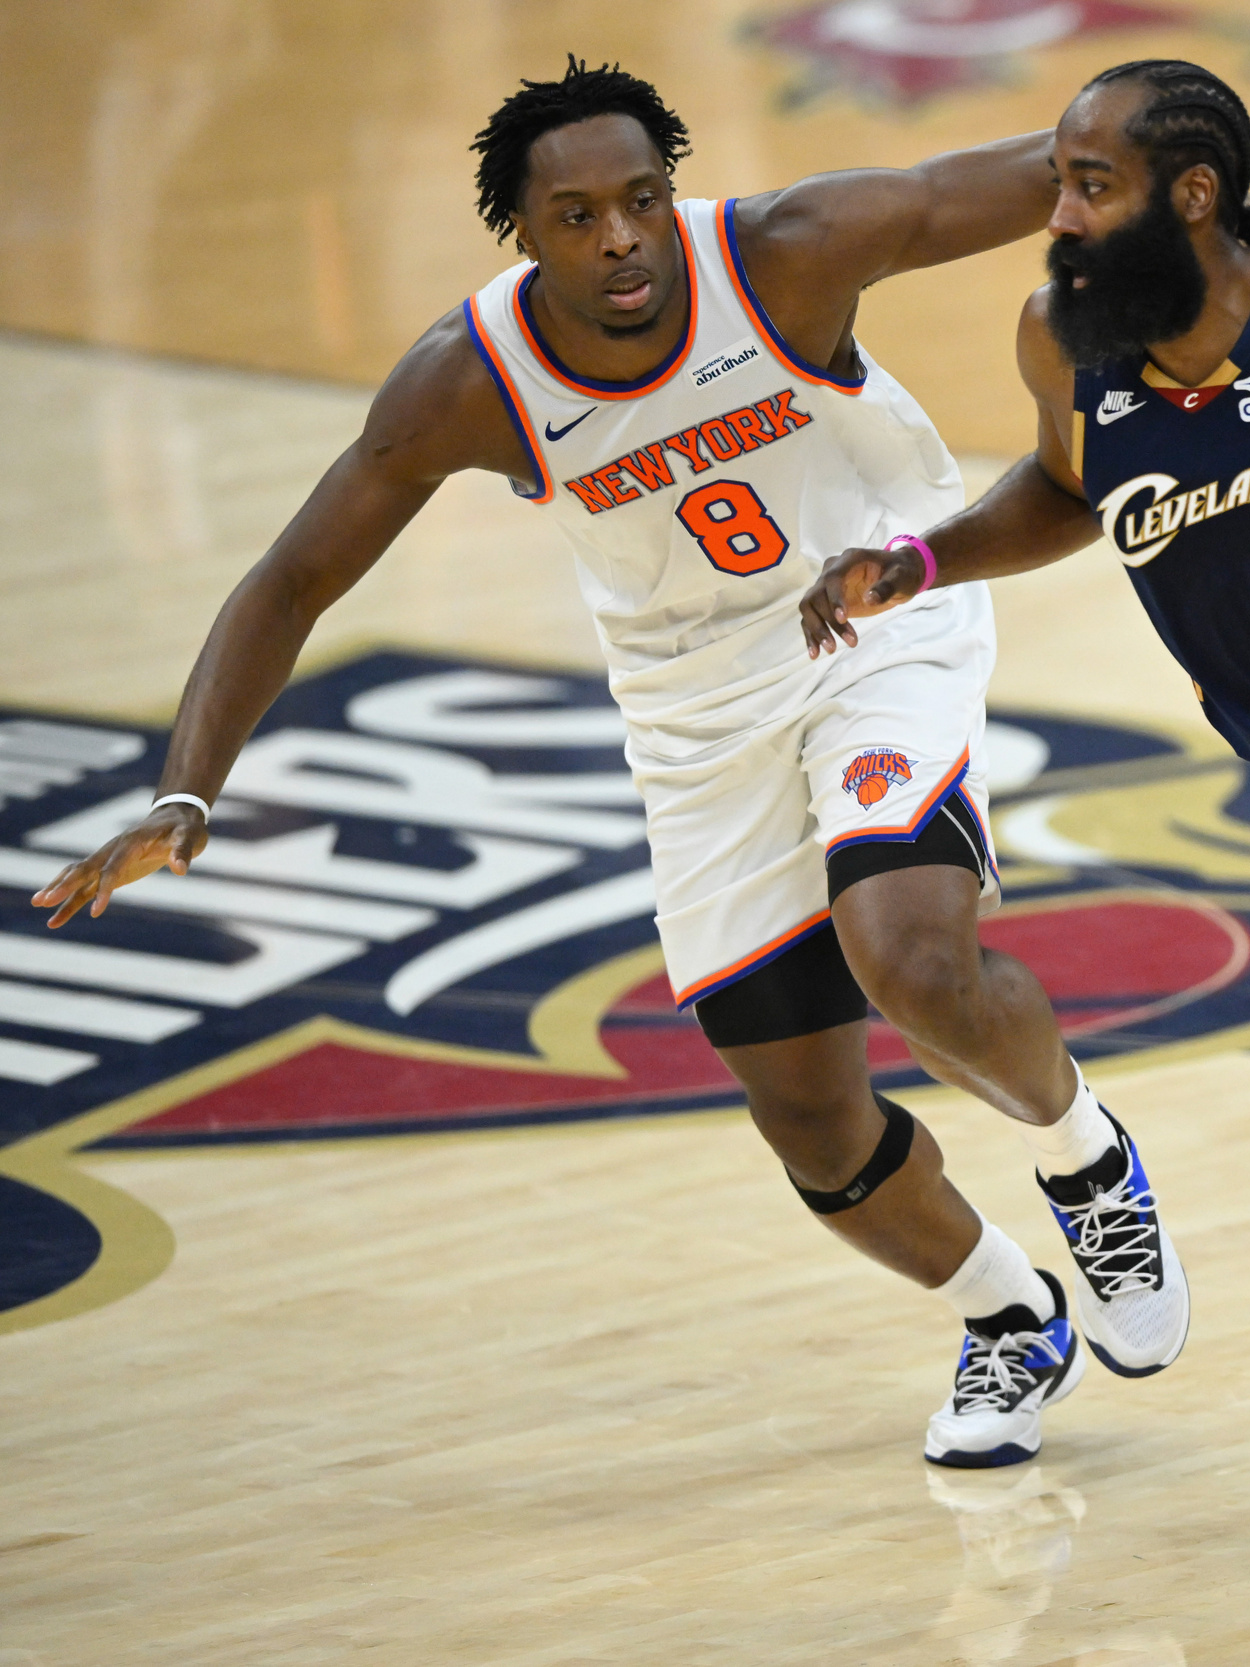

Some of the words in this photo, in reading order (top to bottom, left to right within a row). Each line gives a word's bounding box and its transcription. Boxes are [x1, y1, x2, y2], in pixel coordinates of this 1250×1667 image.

[692, 355, 725, 376] experience
[696, 368, 721, 386] abu
[721, 345, 758, 372] dhabi
[1103, 390, 1134, 411] NIKE
[1183, 393, 1199, 408] C
[564, 441, 678, 515] NEW
[667, 387, 814, 476] YORK
[675, 479, 790, 578] 8
[842, 752, 913, 788] KNICKS
